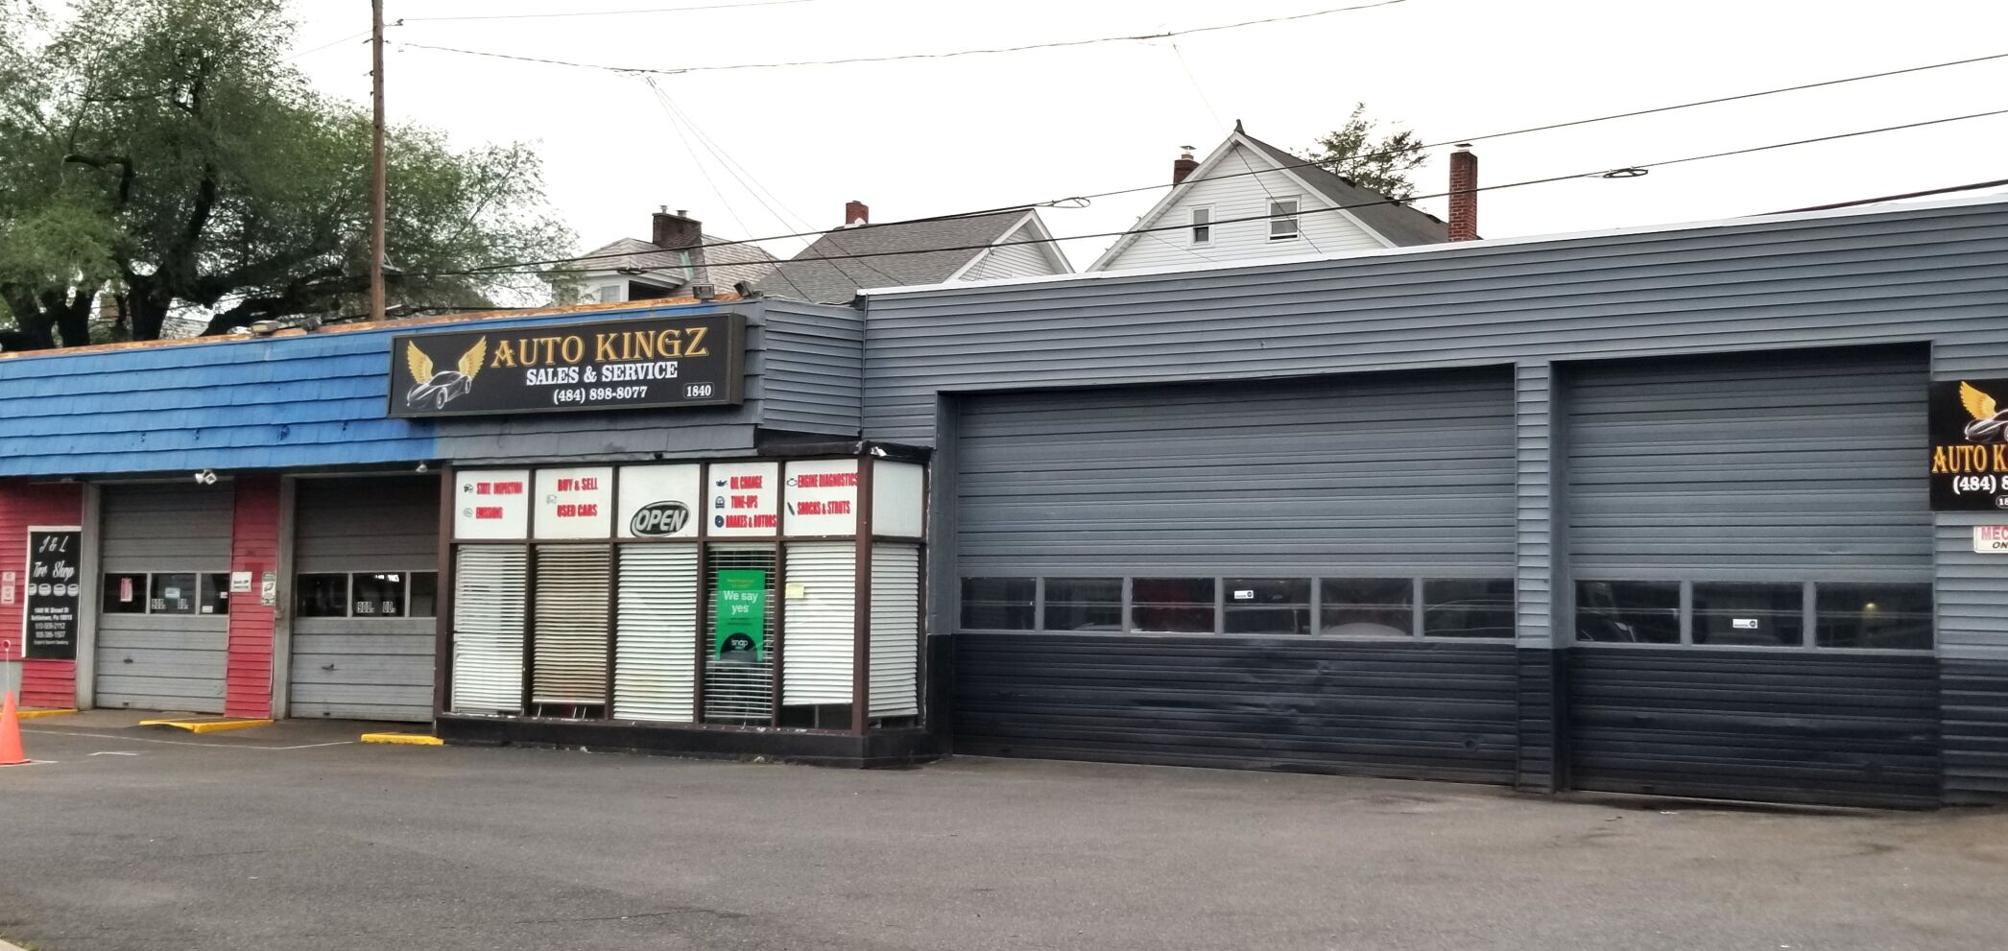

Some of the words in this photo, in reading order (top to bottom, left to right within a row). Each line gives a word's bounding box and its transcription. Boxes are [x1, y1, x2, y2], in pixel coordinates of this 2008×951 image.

[490, 336, 584, 368] AUTO
[596, 327, 710, 362] KINGZ
[526, 365, 579, 386] SALES
[583, 365, 598, 383] &
[602, 361, 678, 382] SERVICE
[553, 387, 586, 405] (484)
[589, 386, 648, 401] 898-8077
[686, 385, 712, 398] 1840
[1931, 444, 1988, 474] AUTO
[558, 478, 573, 492] BUY
[574, 480, 581, 491] &
[582, 477, 599, 490] SELL
[1953, 474, 1997, 495] (484)
[557, 504, 577, 518] USED
[578, 503, 598, 517] CARS
[797, 501, 821, 515] SHOCKS
[828, 501, 851, 514] STRUTS
[635, 508, 687, 533] OPEN
[48, 536, 59, 552] &
[60, 535, 69, 552] L
[53, 560, 74, 581] Shop
[723, 590, 740, 601] We
[741, 593, 758, 603] say
[732, 604, 749, 615] yes
[732, 640, 748, 649] snap
